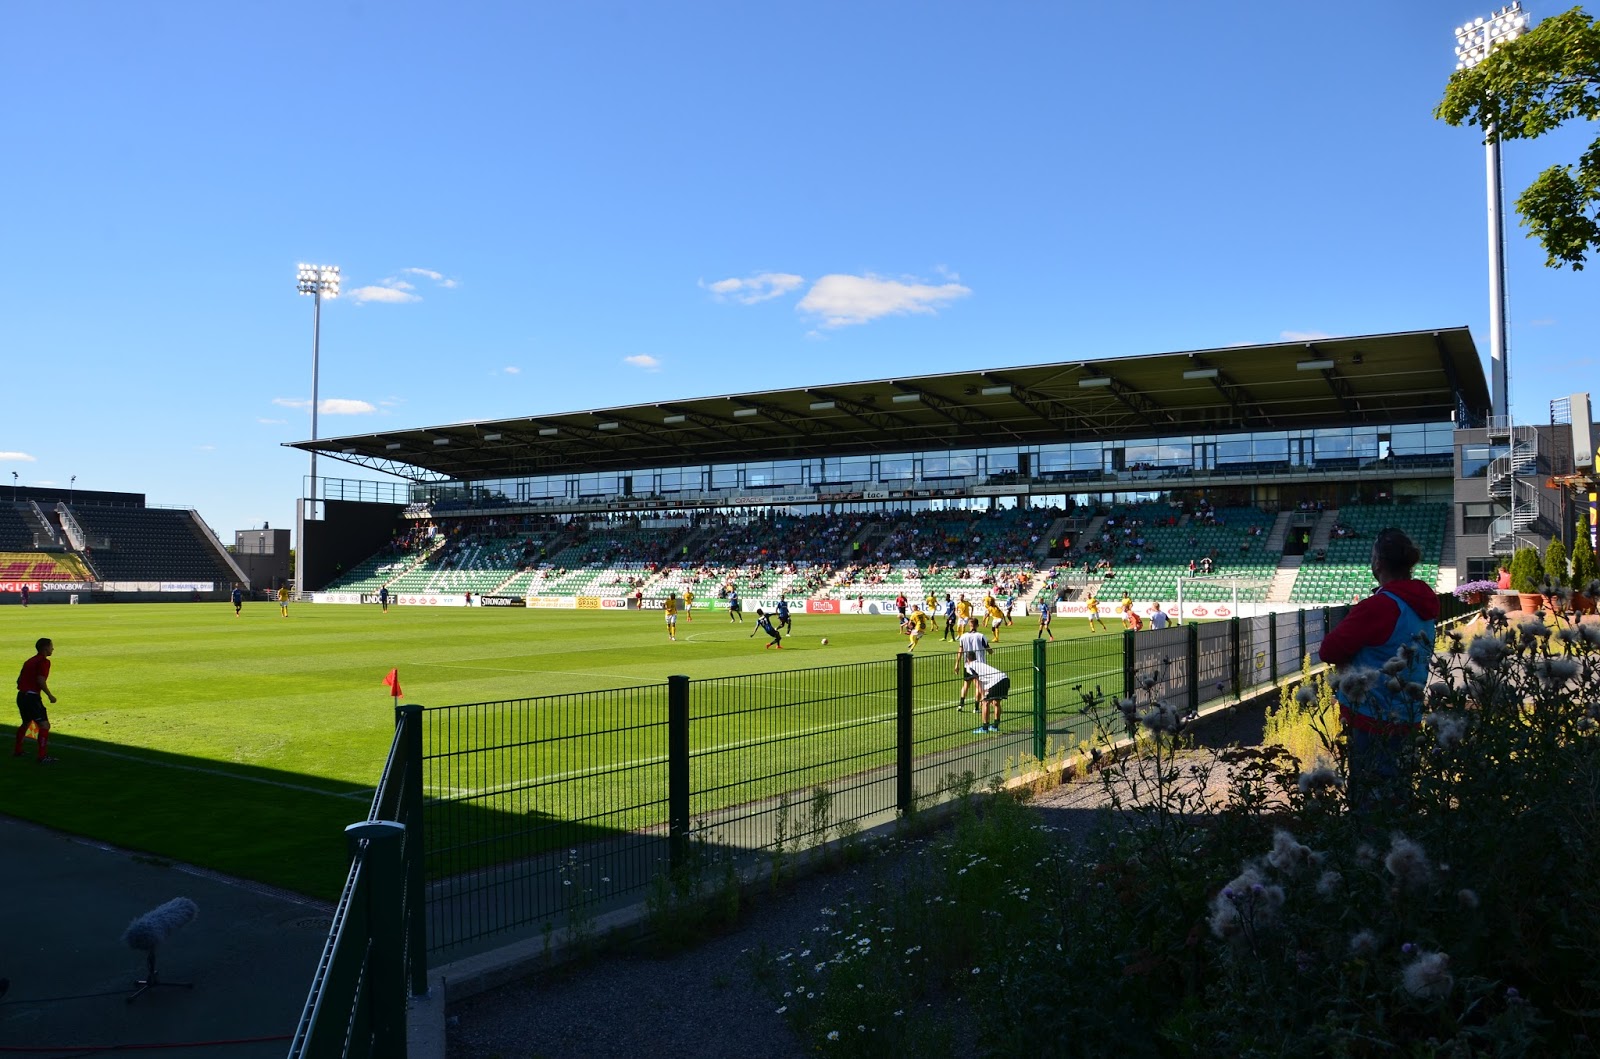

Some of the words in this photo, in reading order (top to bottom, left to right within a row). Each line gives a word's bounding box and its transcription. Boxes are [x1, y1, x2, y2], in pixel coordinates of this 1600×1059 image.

[43, 583, 84, 591] STRONGBOW
[363, 595, 395, 604] LINDOFF
[481, 597, 512, 606] STRONGBOW
[640, 599, 665, 609] SELEC
[714, 600, 731, 608] Europ
[759, 600, 804, 608] VERAS
[1058, 605, 1111, 614] LÄMPÖPSTO
